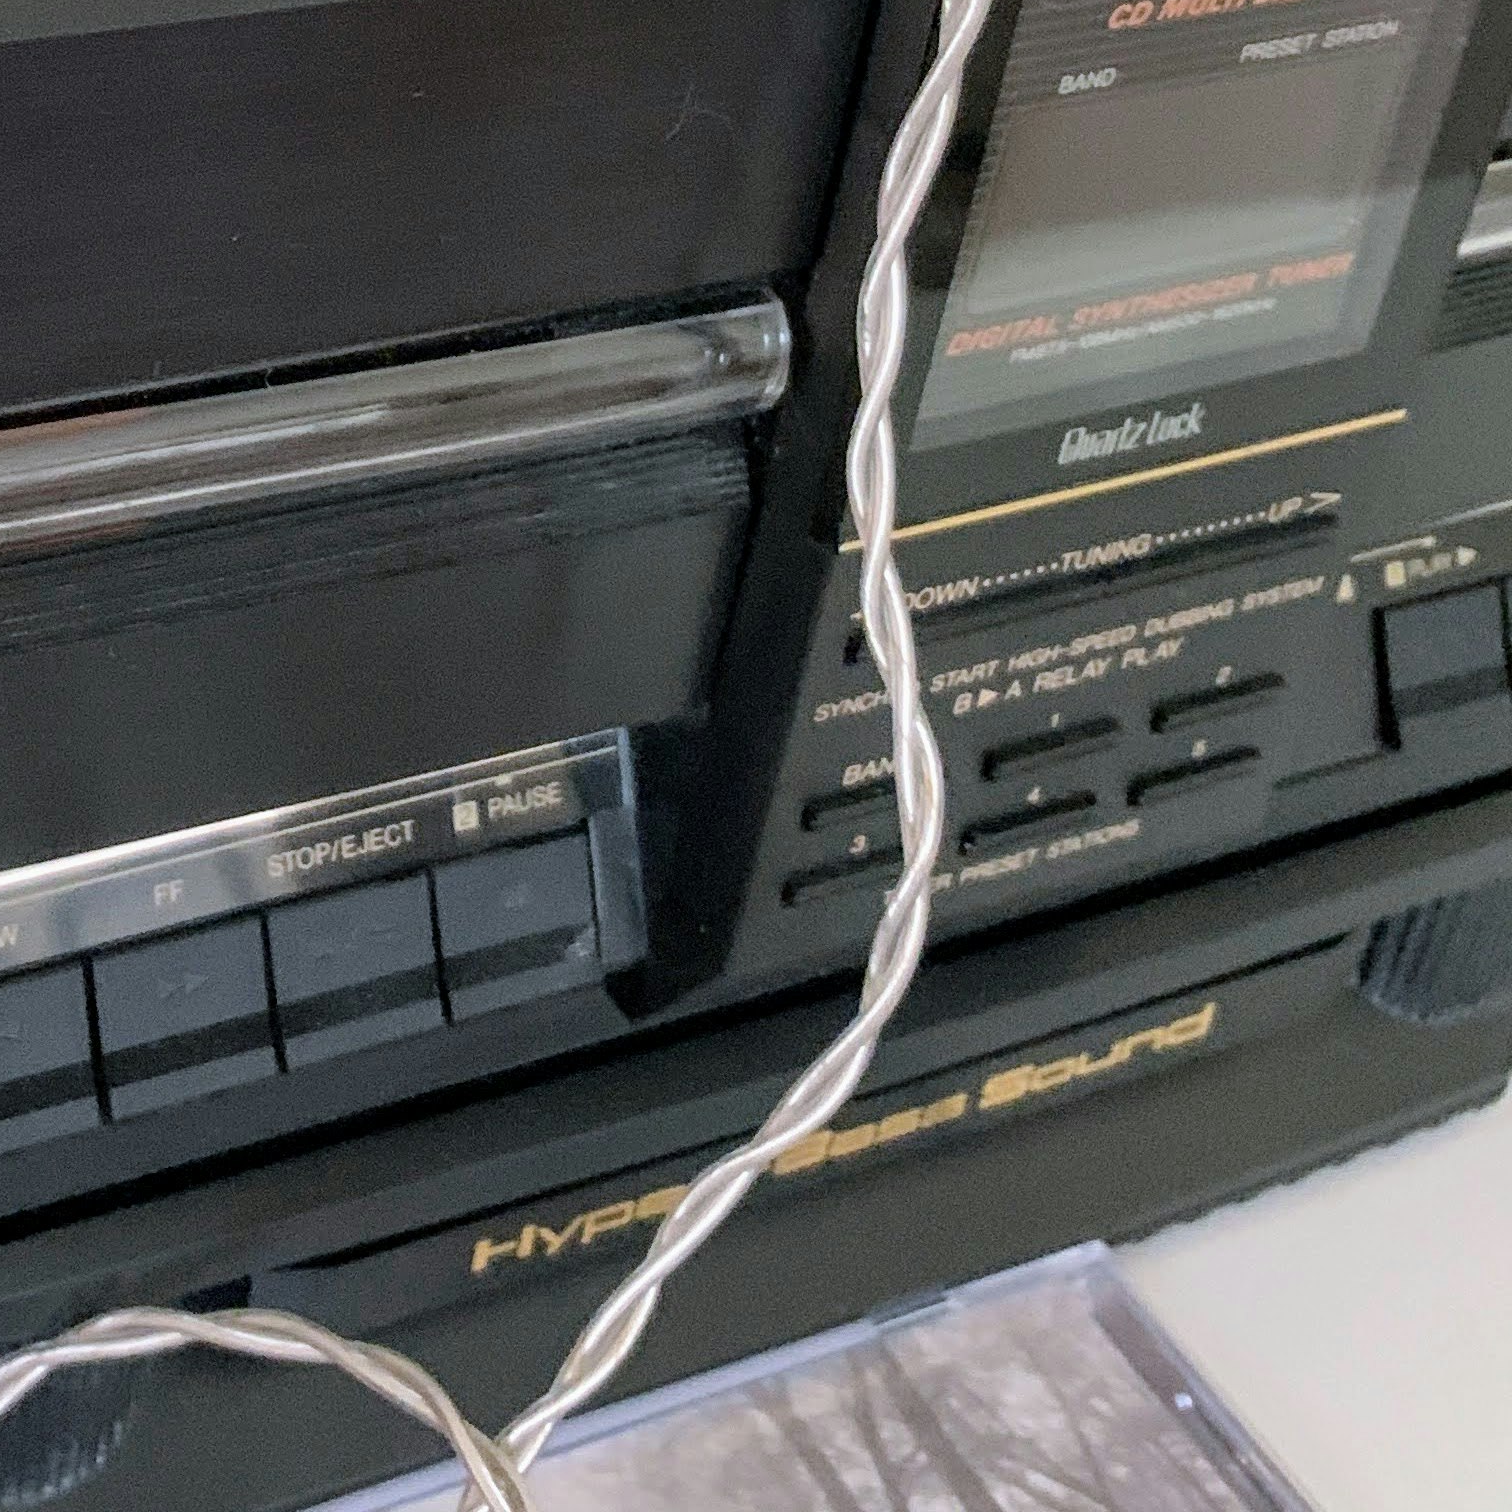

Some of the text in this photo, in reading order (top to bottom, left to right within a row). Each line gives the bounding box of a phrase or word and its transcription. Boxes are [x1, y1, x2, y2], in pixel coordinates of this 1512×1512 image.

[1107, 0, 1155, 31] CD
[1057, 67, 1117, 95] BAND
[1058, 533, 1152, 572] TUNING
[929, 659, 1001, 693] START
[1033, 657, 1111, 692] RELAY
[1121, 636, 1185, 670] PLAY
[842, 756, 894, 786] BAN
[487, 781, 564, 821] PAUSE
[267, 818, 417, 878] STOP/EJECT
[153, 879, 184, 906] FF
